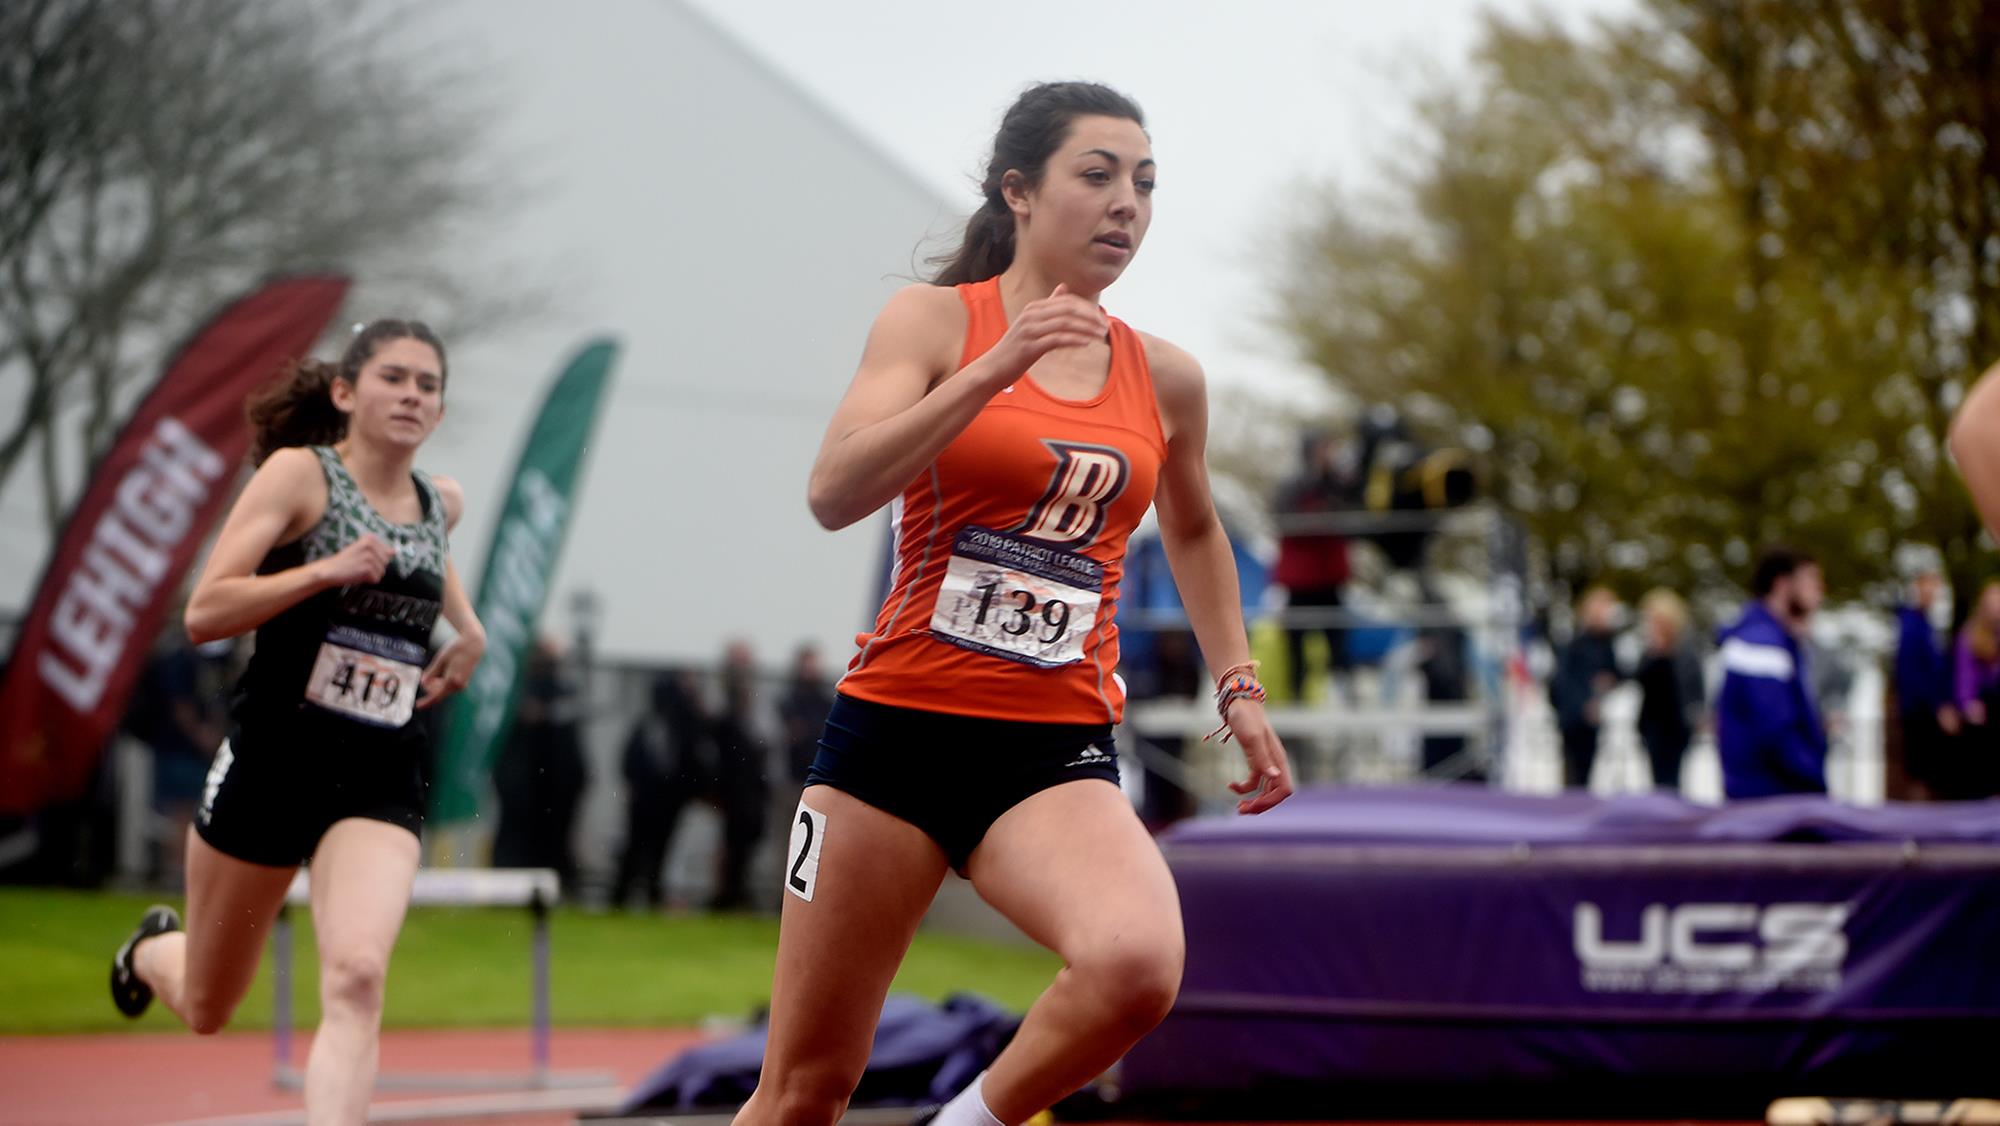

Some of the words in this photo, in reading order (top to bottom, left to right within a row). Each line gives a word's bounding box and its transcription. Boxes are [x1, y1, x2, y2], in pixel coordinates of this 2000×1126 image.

[1008, 440, 1129, 549] B
[38, 417, 225, 714] LEHIGH
[1002, 538, 1053, 562] PATRIOT
[1053, 553, 1096, 576] LEAGUE
[974, 581, 1070, 644] 139
[331, 664, 400, 709] 419
[790, 811, 813, 893] 2
[1574, 902, 1847, 969] UCS
